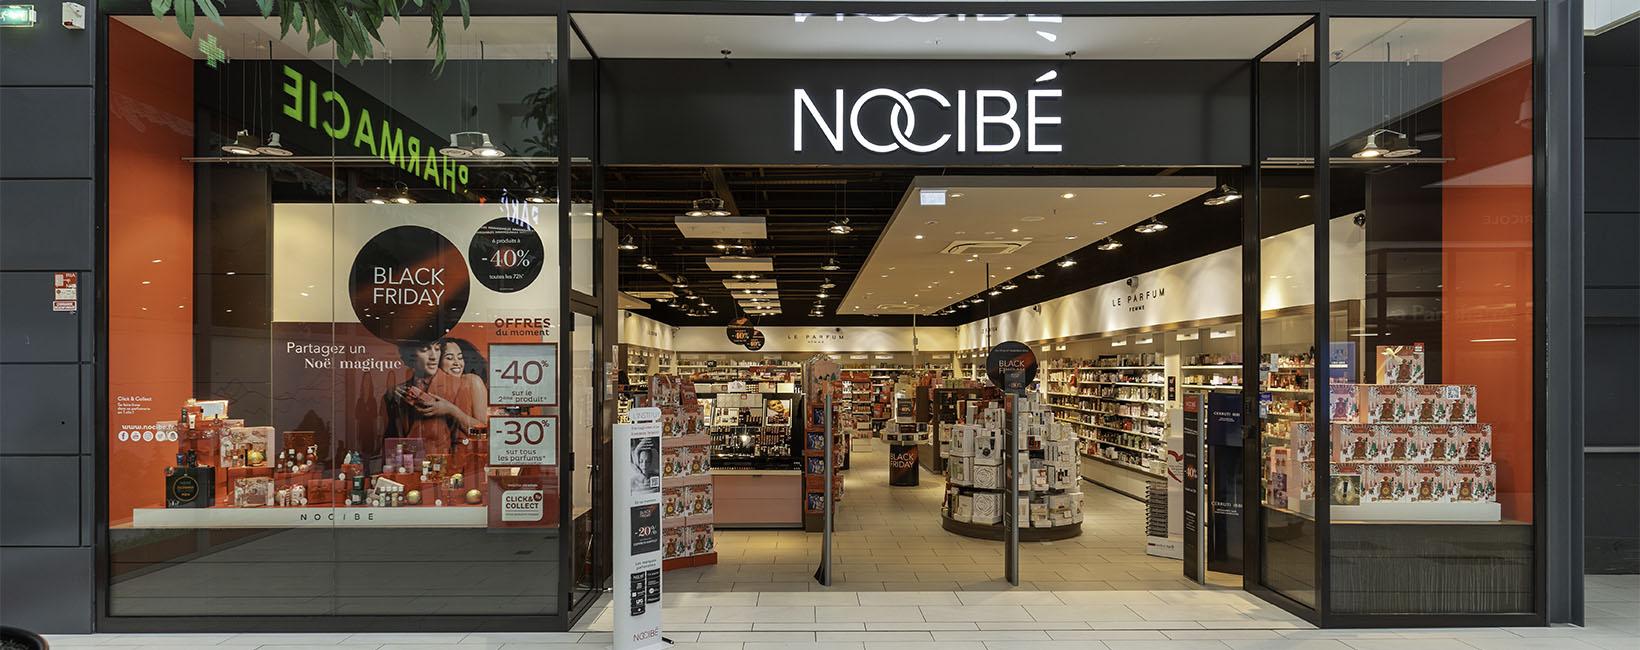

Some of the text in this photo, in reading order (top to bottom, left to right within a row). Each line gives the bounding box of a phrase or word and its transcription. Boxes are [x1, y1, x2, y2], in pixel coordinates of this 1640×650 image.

[794, 70, 1063, 153] NOCIBÉ
[481, 249, 530, 267] -40%
[374, 266, 444, 286] BLACK
[373, 287, 445, 306] FRIDAY
[1112, 288, 1165, 307] LE PARFUM
[495, 318, 551, 329] OFFRES
[286, 342, 366, 357] Partagez un
[340, 358, 402, 371] magique
[495, 360, 549, 385] -40%
[496, 419, 550, 445] -30%
[300, 513, 374, 521] NOCIBE
